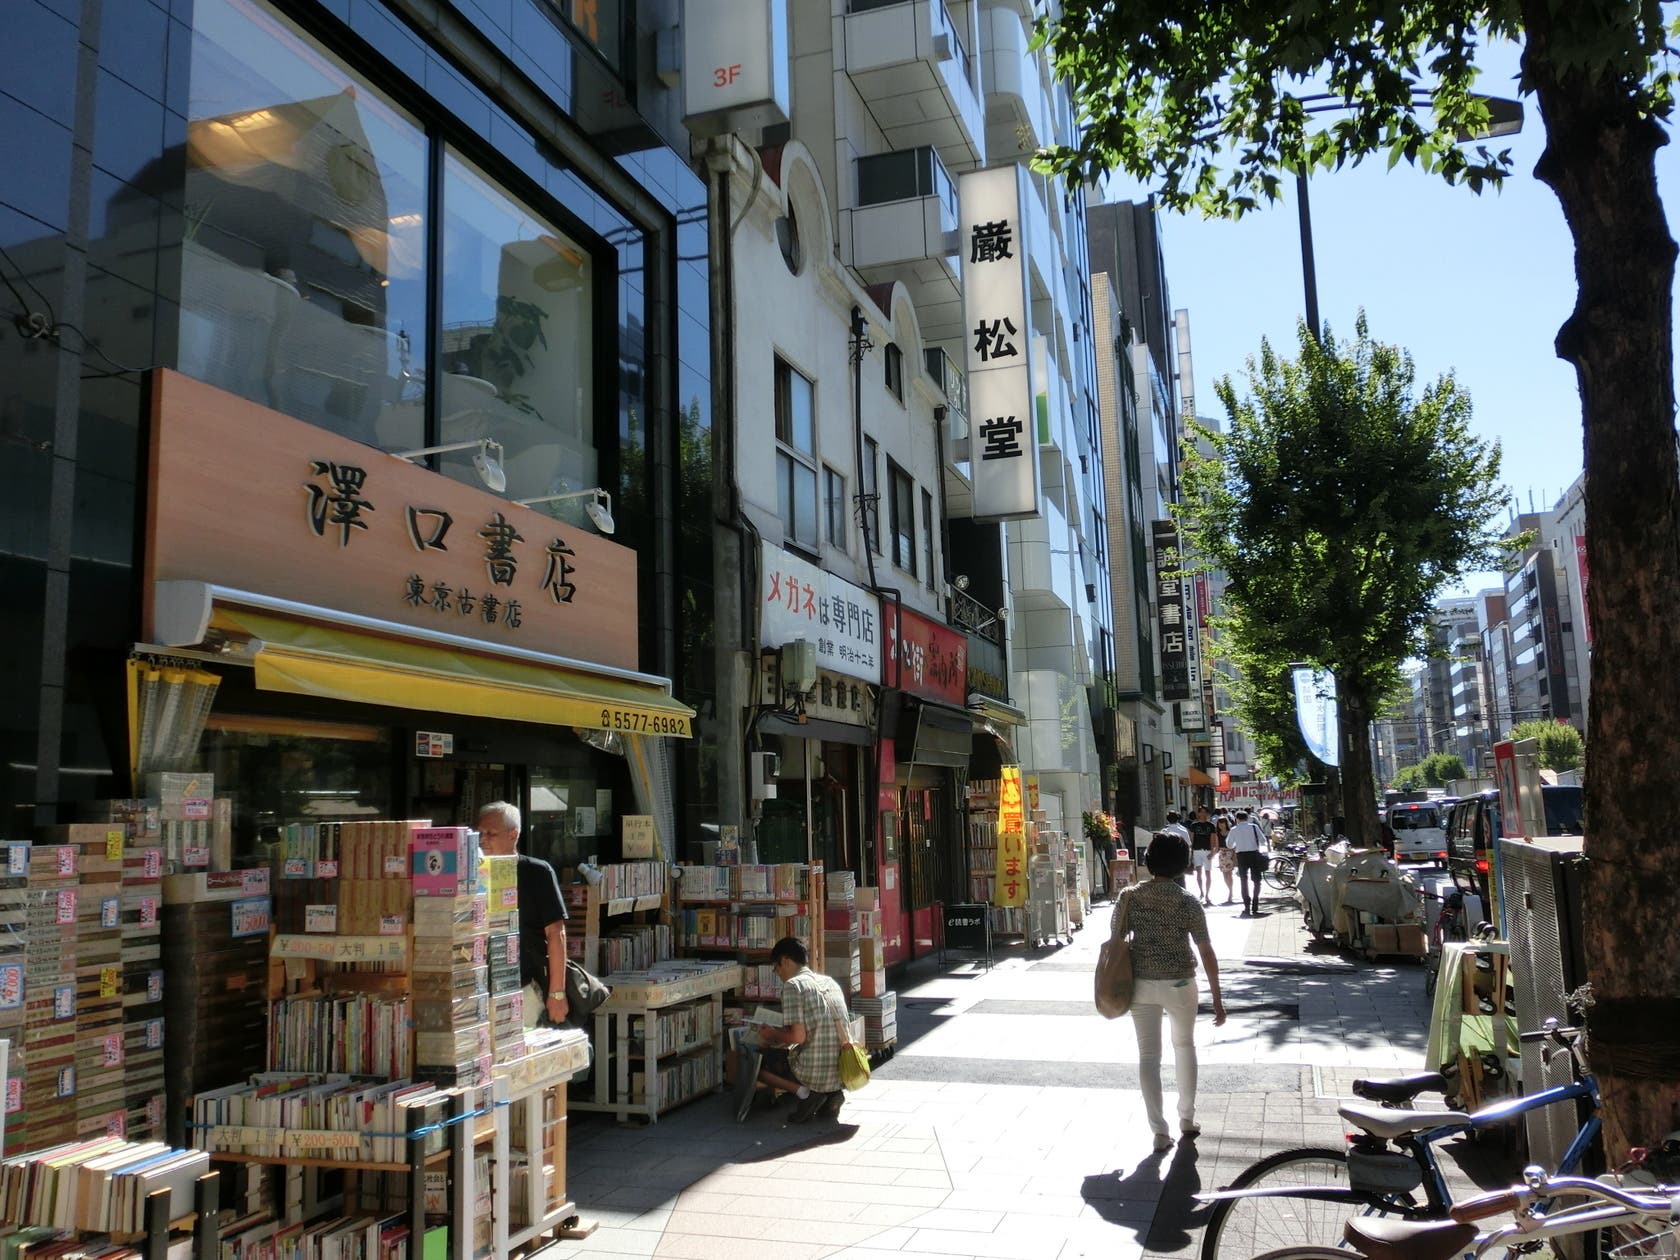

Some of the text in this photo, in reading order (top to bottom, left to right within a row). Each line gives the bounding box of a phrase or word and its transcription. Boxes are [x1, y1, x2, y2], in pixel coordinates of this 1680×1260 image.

[713, 64, 742, 88] 3F
[304, 461, 577, 604] 澤口書店
[403, 574, 522, 629] 東京古書店
[768, 571, 874, 645] メガネは専門店
[615, 712, 686, 735] 5577-6982
